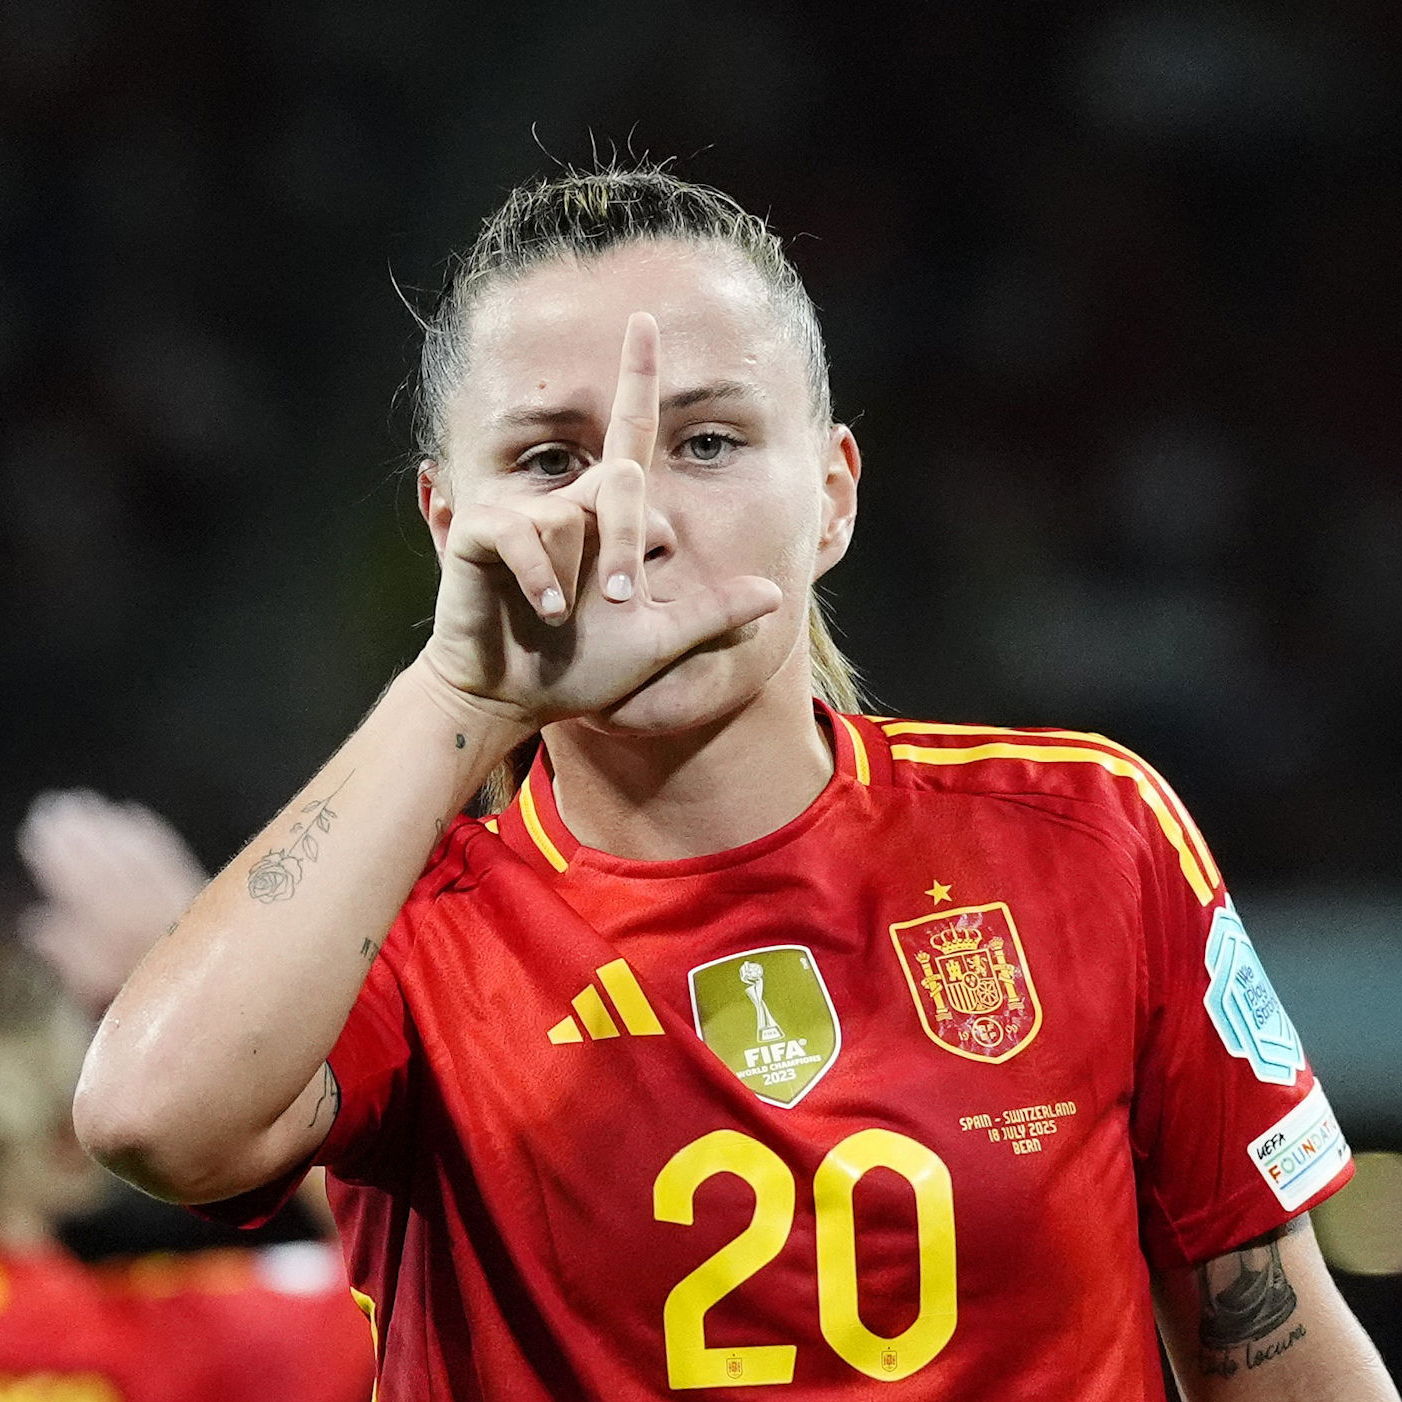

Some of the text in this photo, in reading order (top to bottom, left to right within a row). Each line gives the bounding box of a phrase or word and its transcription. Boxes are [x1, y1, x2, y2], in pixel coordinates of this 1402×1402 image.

[736, 1055, 822, 1079] WORLD CHAMPIONS
[763, 1068, 796, 1086] 2023
[959, 1113, 993, 1131] SPAIN
[1002, 1101, 1077, 1125] SWITZERLAND
[988, 1119, 1058, 1143] 18 JULY 2025
[1011, 1138, 1042, 1155] BERN
[1257, 1132, 1286, 1160] UEFA
[653, 1128, 958, 1390] 20
